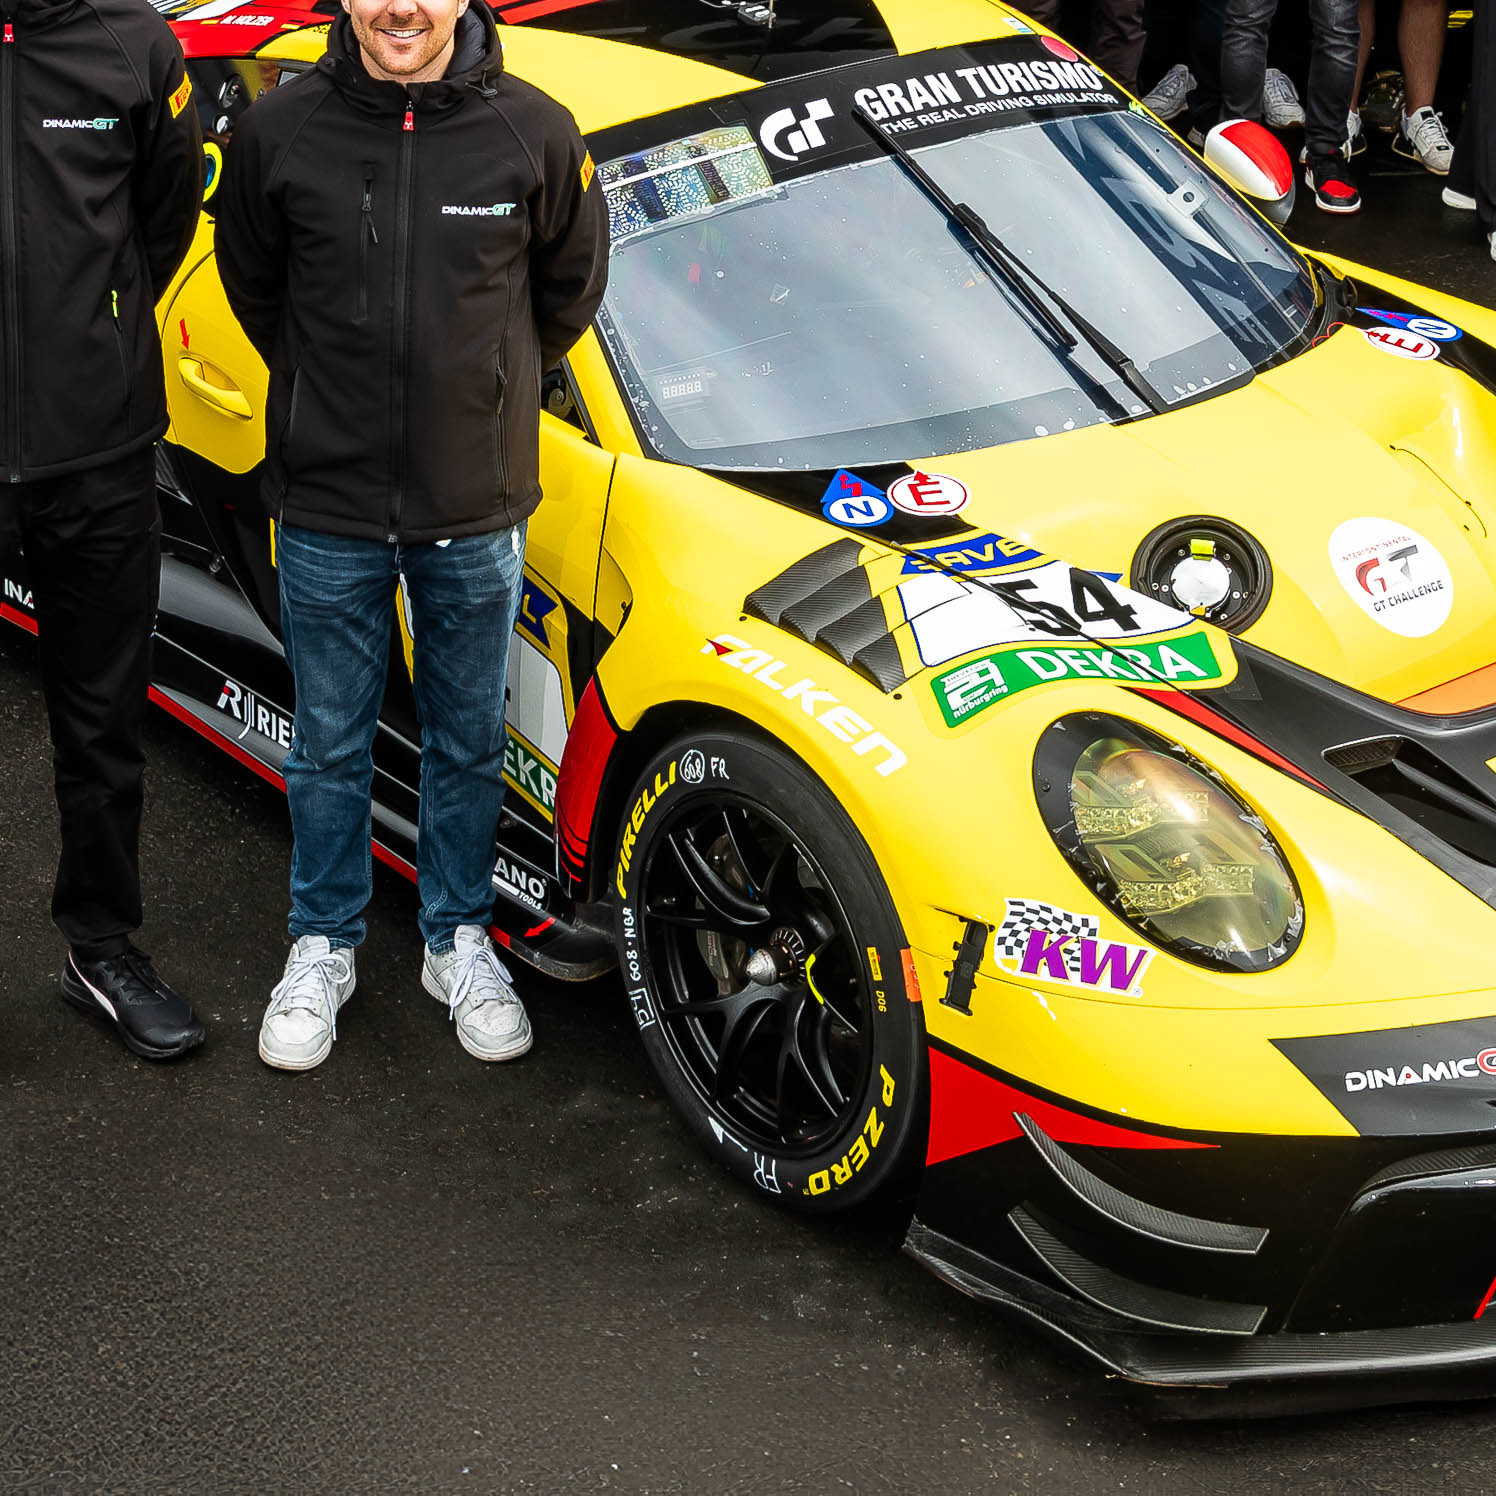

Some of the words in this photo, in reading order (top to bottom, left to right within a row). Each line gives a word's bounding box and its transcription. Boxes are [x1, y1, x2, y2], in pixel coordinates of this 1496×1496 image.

[855, 70, 963, 123] GRAN
[880, 117, 916, 137] THE
[917, 109, 966, 130] REAL
[967, 97, 1033, 117] DRIVING
[1035, 92, 1119, 106] SIMULATOR
[842, 500, 875, 519] N
[991, 567, 1142, 637] 54
[1373, 599, 1387, 612] GT
[1387, 579, 1445, 608] CHALLENGE
[1015, 644, 1208, 682] DEKRA
[700, 634, 908, 777] FALKEN
[953, 683, 1009, 719] nürburgring
[257, 703, 297, 752] RIE
[503, 738, 557, 809] EKR
[615, 760, 677, 900] PIRELLI
[493, 856, 546, 900] ANO
[517, 890, 543, 911] TOOLS
[1019, 928, 1149, 990] KW
[880, 1063, 896, 1108] P
[808, 1105, 891, 1196] ZERO
